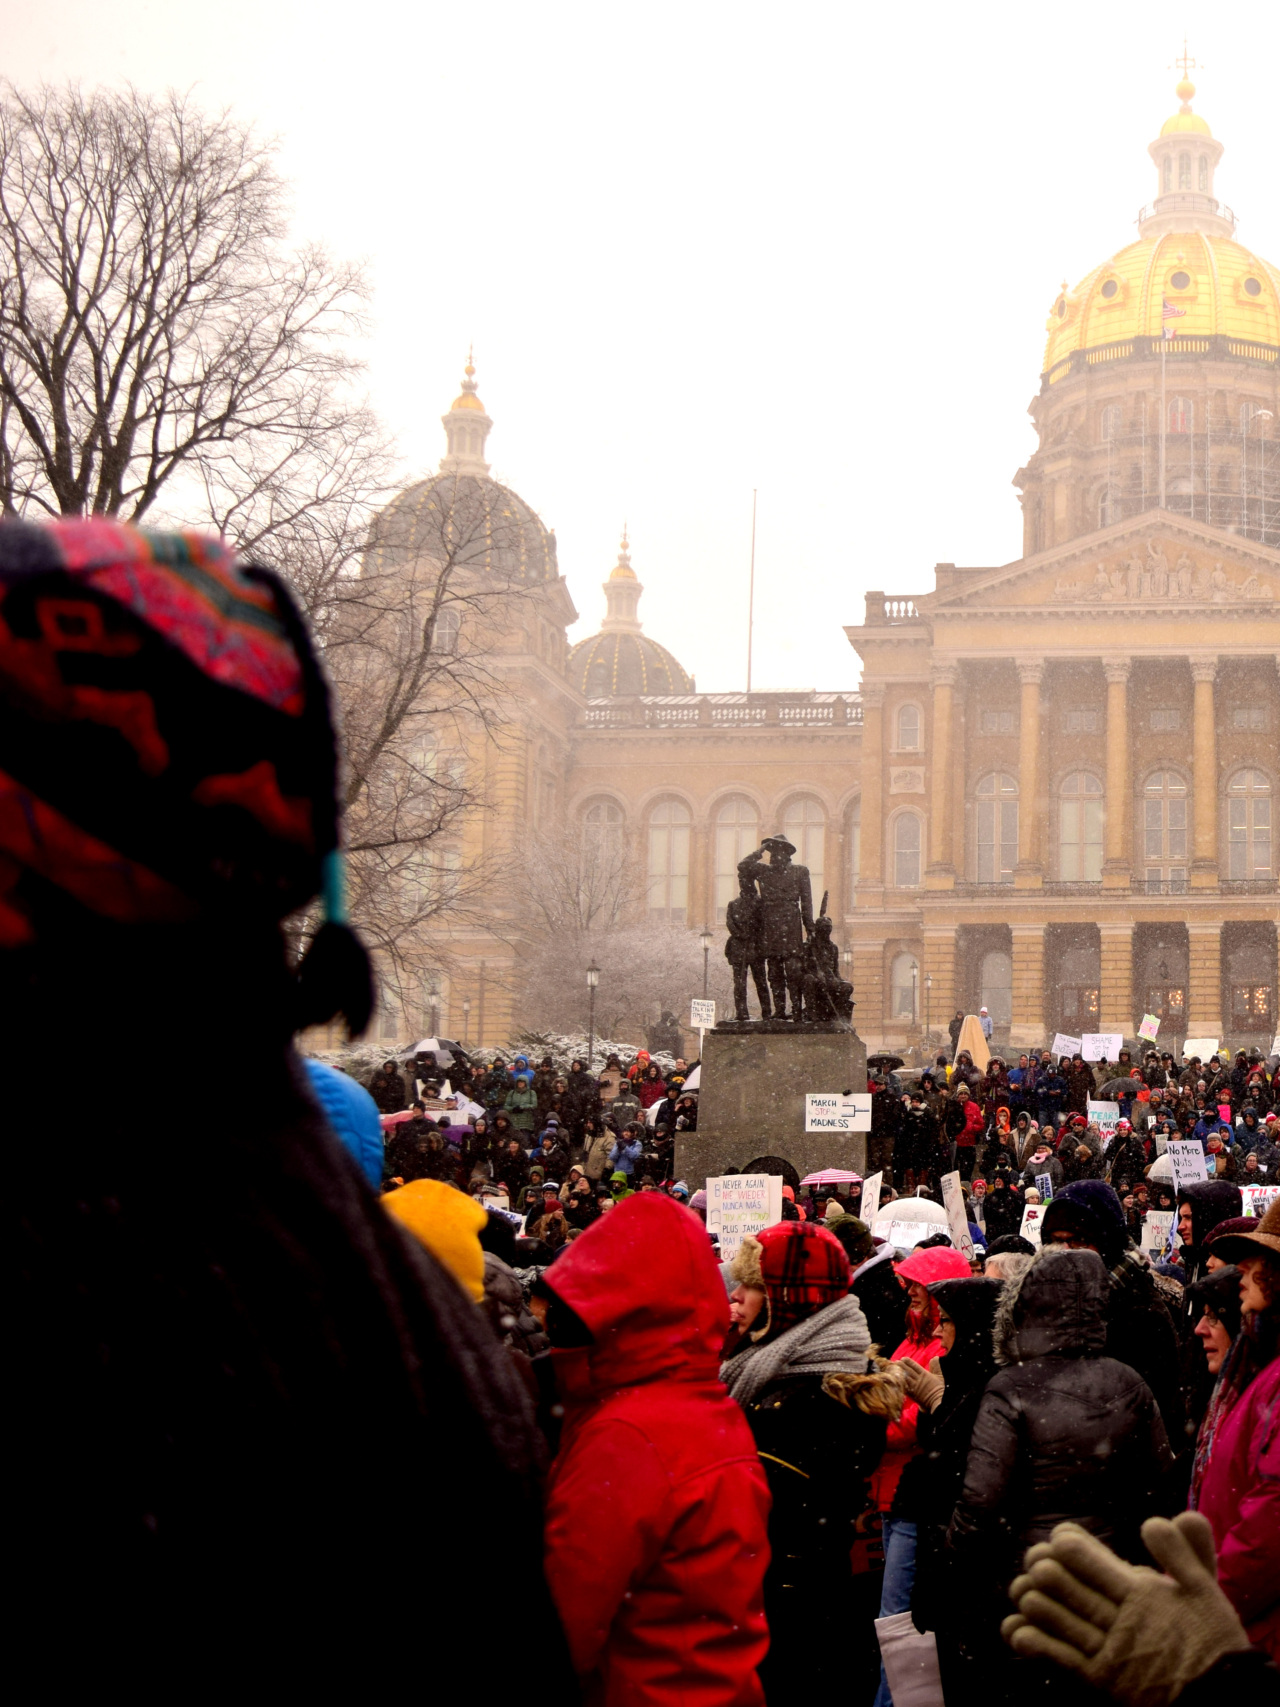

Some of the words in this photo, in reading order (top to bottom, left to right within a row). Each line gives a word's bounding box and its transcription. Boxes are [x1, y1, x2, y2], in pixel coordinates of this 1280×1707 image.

[1091, 1037, 1113, 1045] SHAME
[811, 1099, 837, 1108] MARCH
[815, 1107, 831, 1116] STOP
[1090, 1111, 1119, 1121] TEARS
[811, 1118, 849, 1129] MADNESS
[1169, 1144, 1180, 1155] No
[1181, 1144, 1201, 1155] More
[1172, 1157, 1193, 1167] Nuts
[1174, 1168, 1202, 1180] Running
[723, 1180, 742, 1189] NEVER
[722, 1190, 733, 1200] NIE
[737, 1190, 766, 1200] WIEDER
[722, 1202, 744, 1211] NUNCA
[722, 1224, 739, 1234] PLUS
[742, 1223, 766, 1233] JAMAIS
